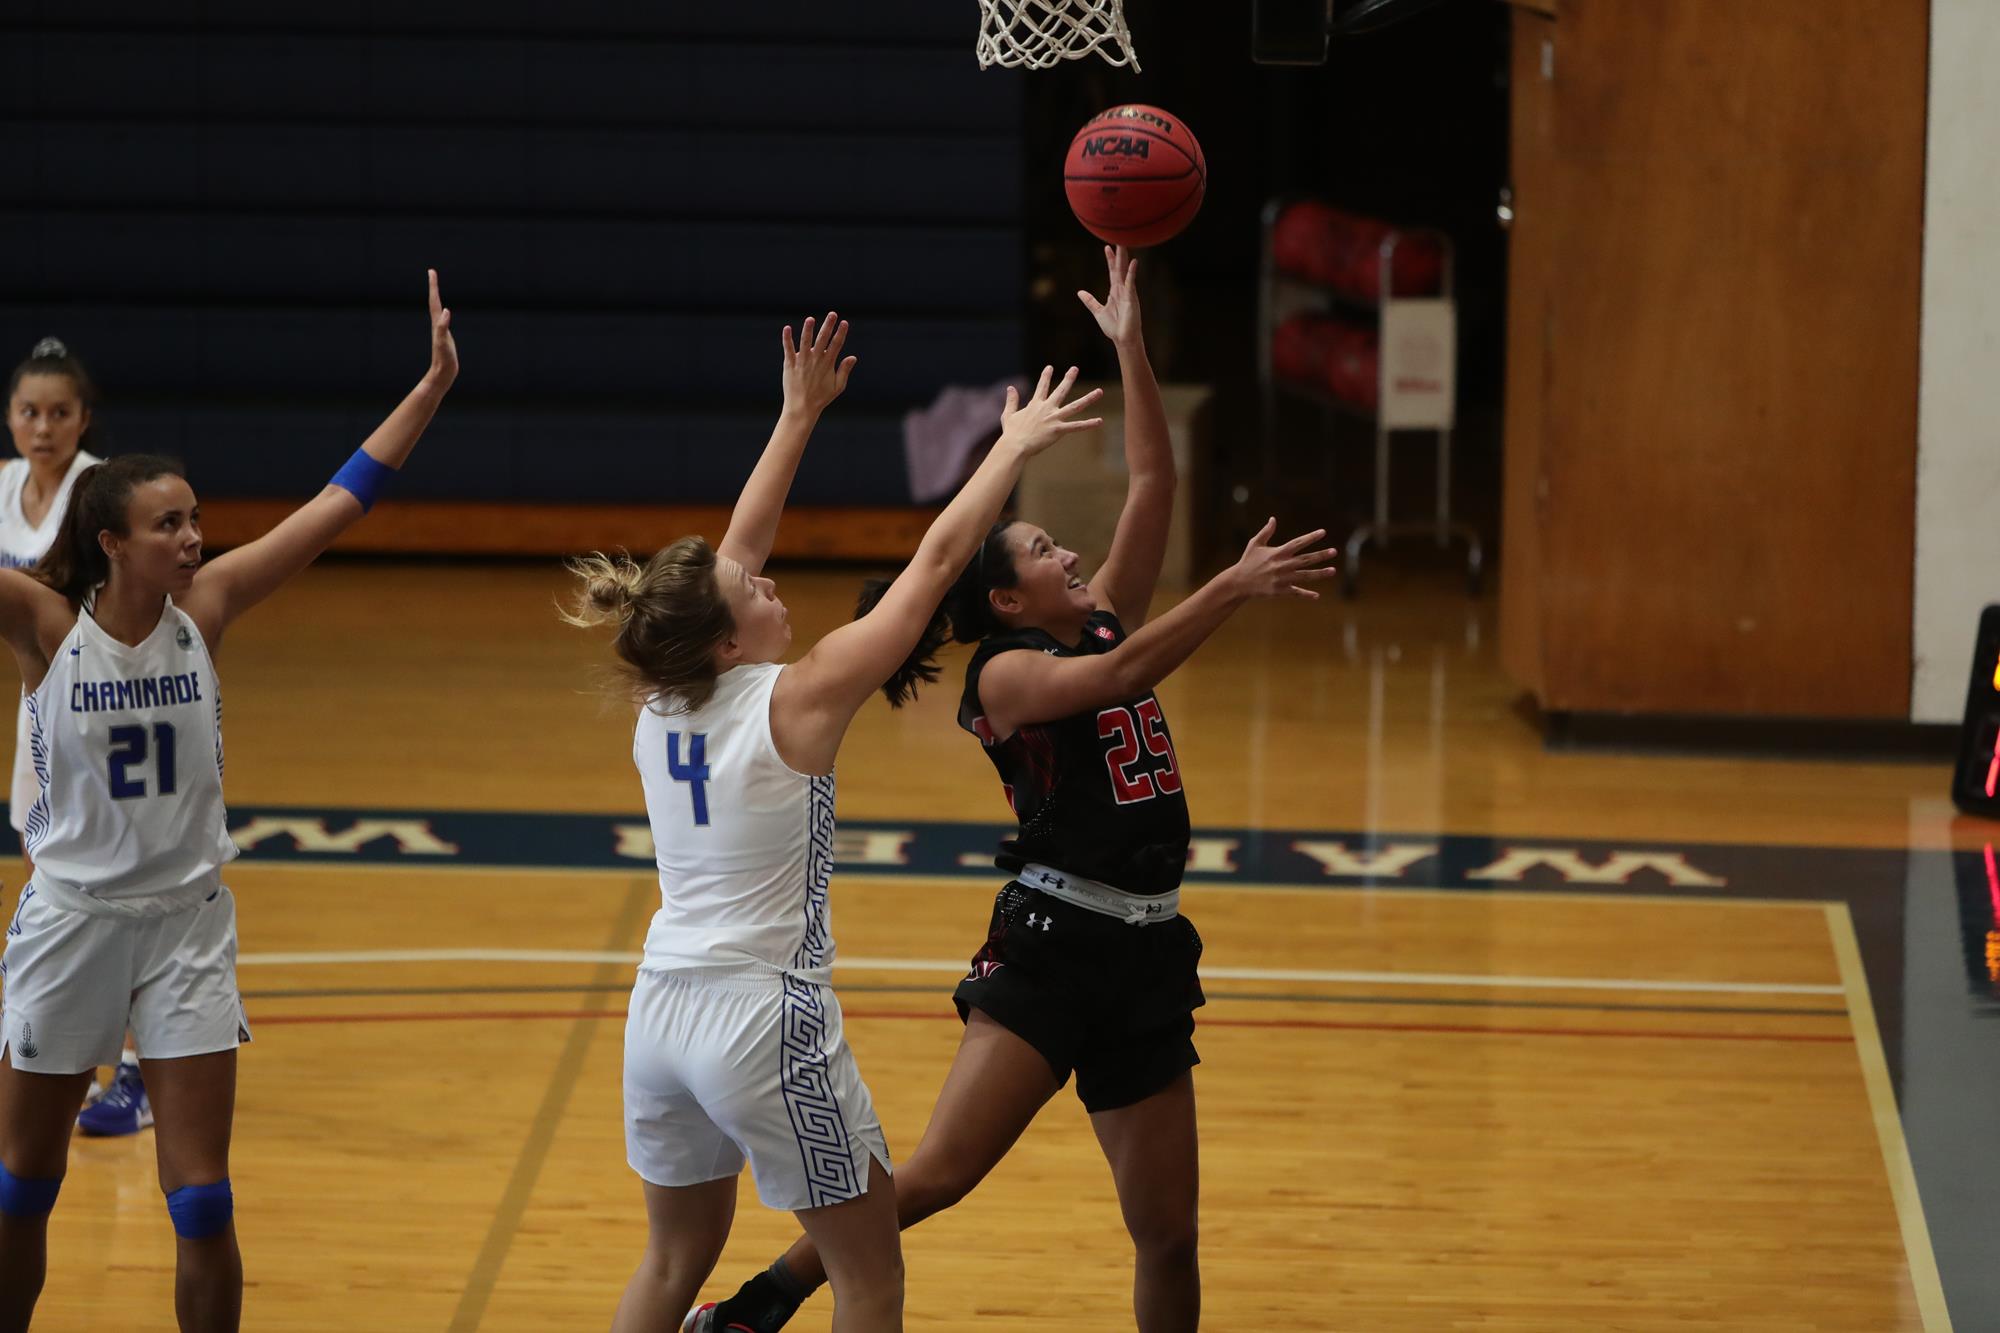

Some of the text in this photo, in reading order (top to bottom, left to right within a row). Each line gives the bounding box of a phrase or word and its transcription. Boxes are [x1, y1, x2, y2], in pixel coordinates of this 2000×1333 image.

[1081, 136, 1151, 160] NCAA
[71, 672, 202, 712] CHAMINADE
[107, 721, 177, 801] 21
[666, 730, 711, 827] 4
[1097, 698, 1181, 804] 25
